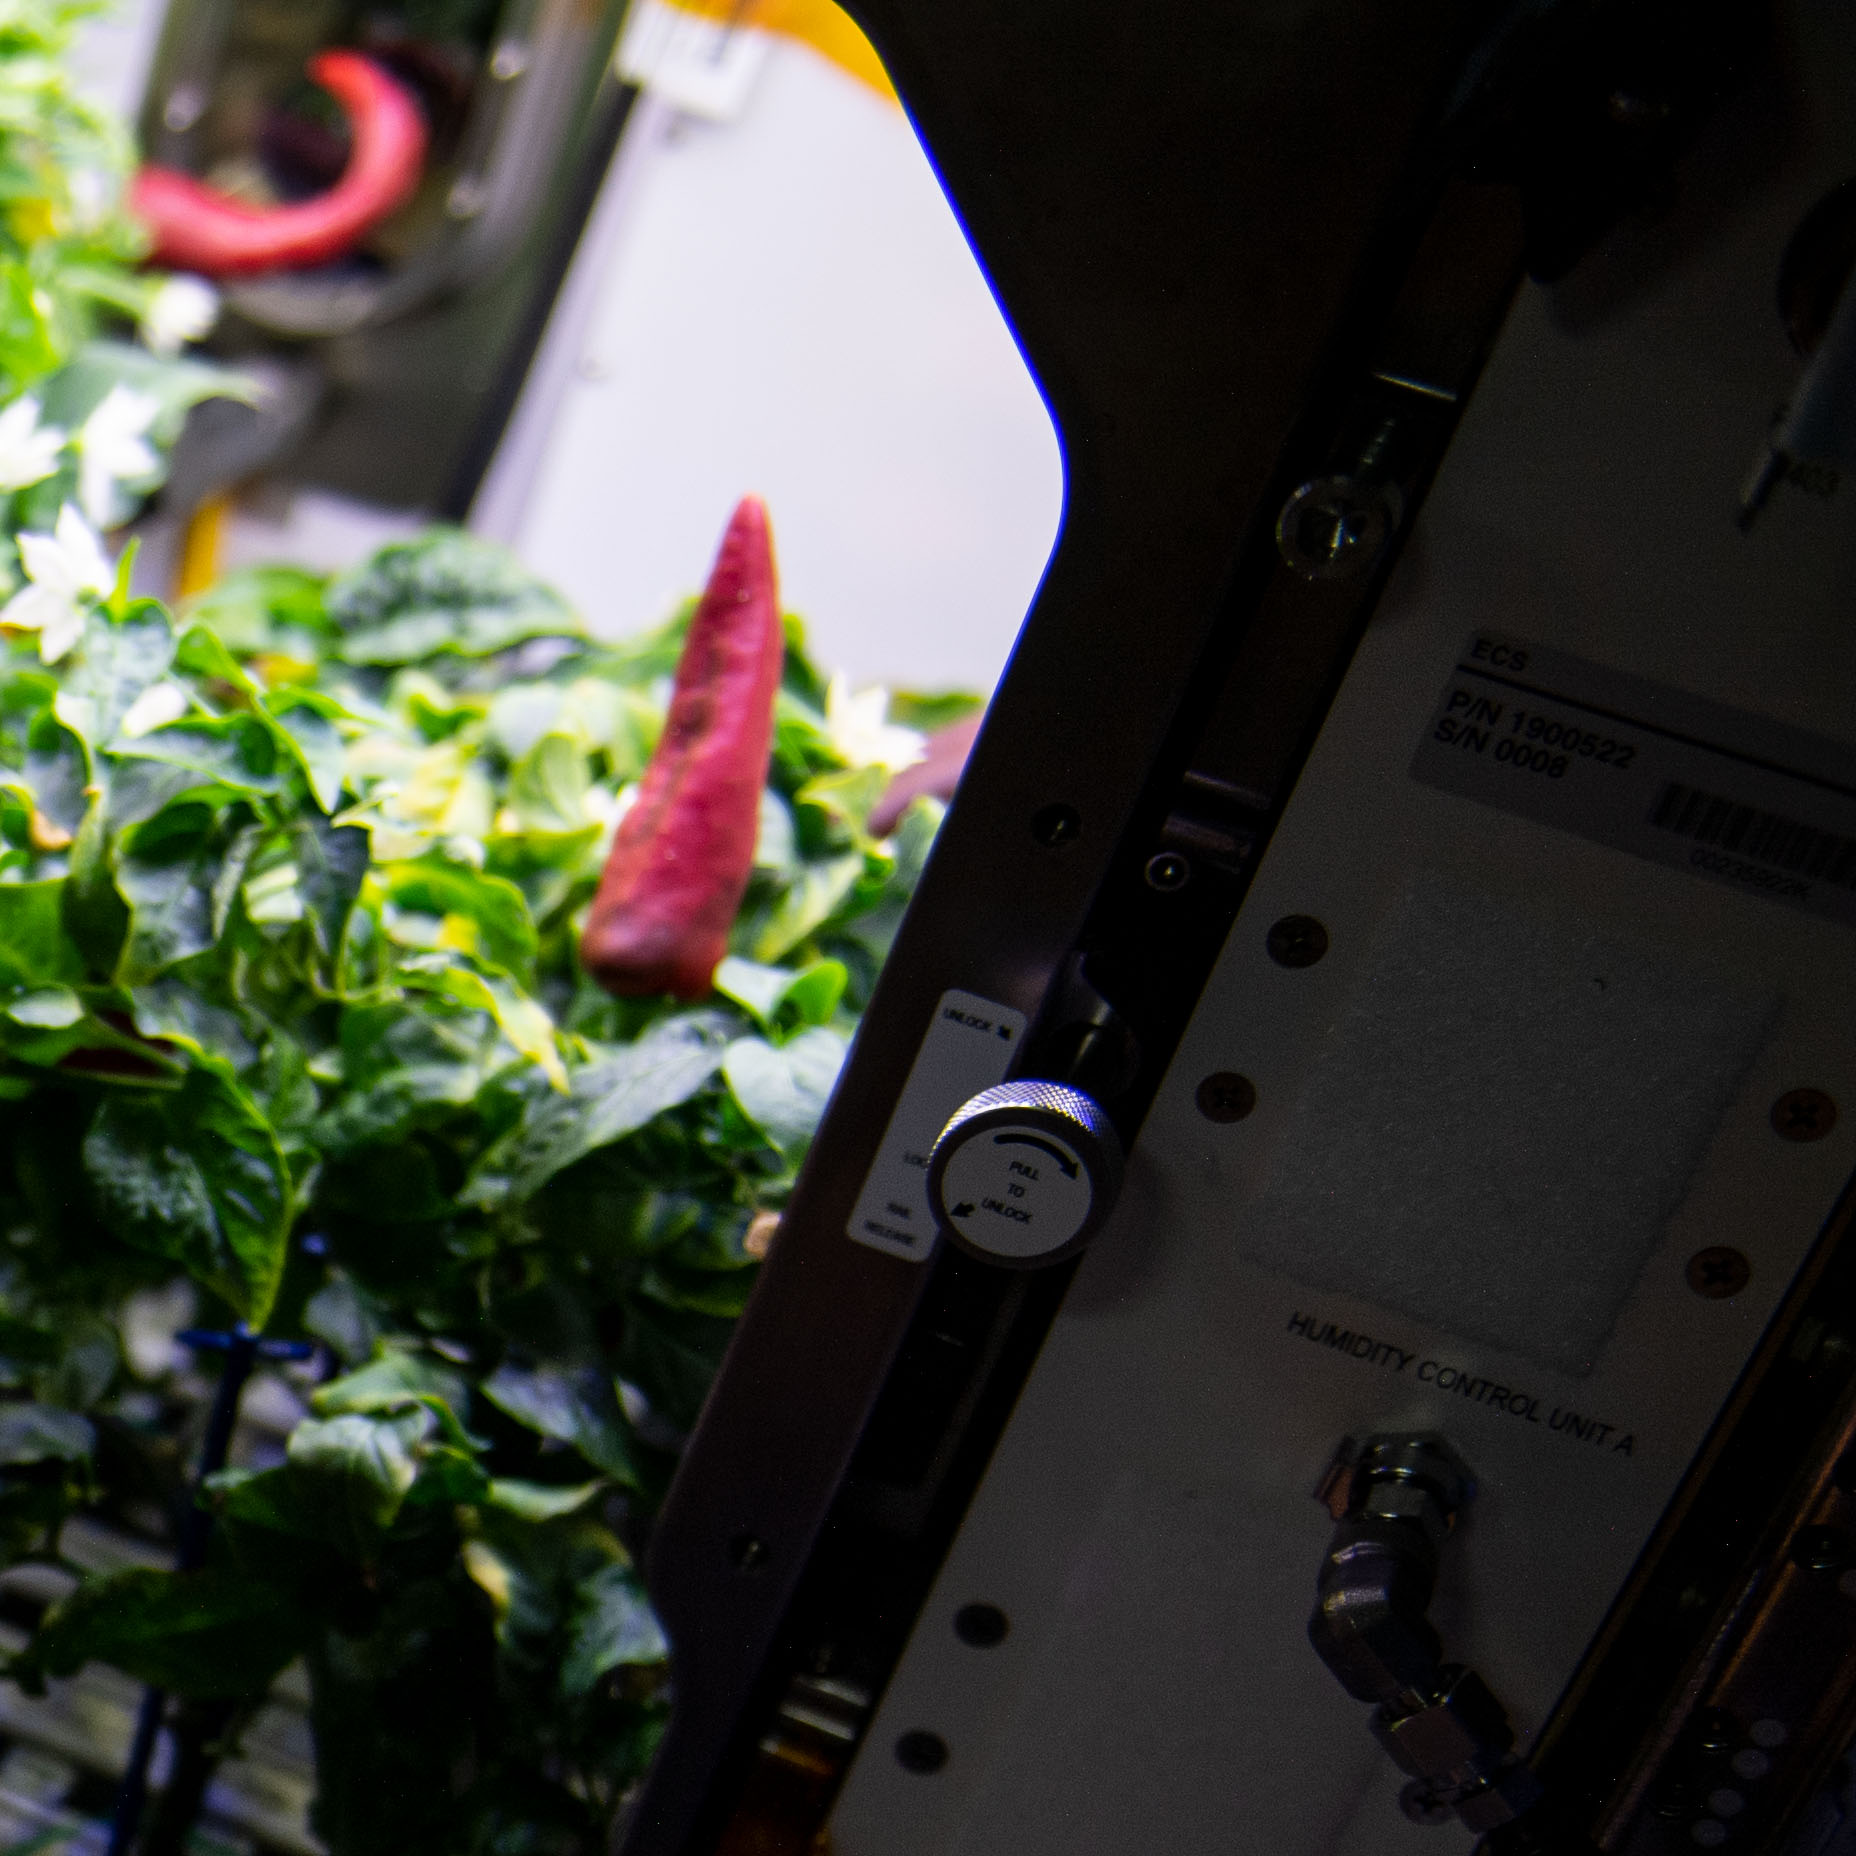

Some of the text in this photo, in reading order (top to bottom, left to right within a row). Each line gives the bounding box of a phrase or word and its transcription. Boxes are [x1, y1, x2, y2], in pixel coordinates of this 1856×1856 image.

[1472, 638, 1529, 672] ECS
[1447, 690, 1637, 769] P/N 1900522
[1435, 719, 1569, 779] S/N 0008
[943, 1008, 992, 1031] UNLOCK
[904, 1152, 928, 1171] LOC
[1008, 1160, 1039, 1181] PULL
[1008, 1183, 1025, 1198] TO
[981, 1198, 1033, 1224] UNLOCK
[1287, 1311, 1635, 1456] HUMIDITY CONTROL UNIT A
